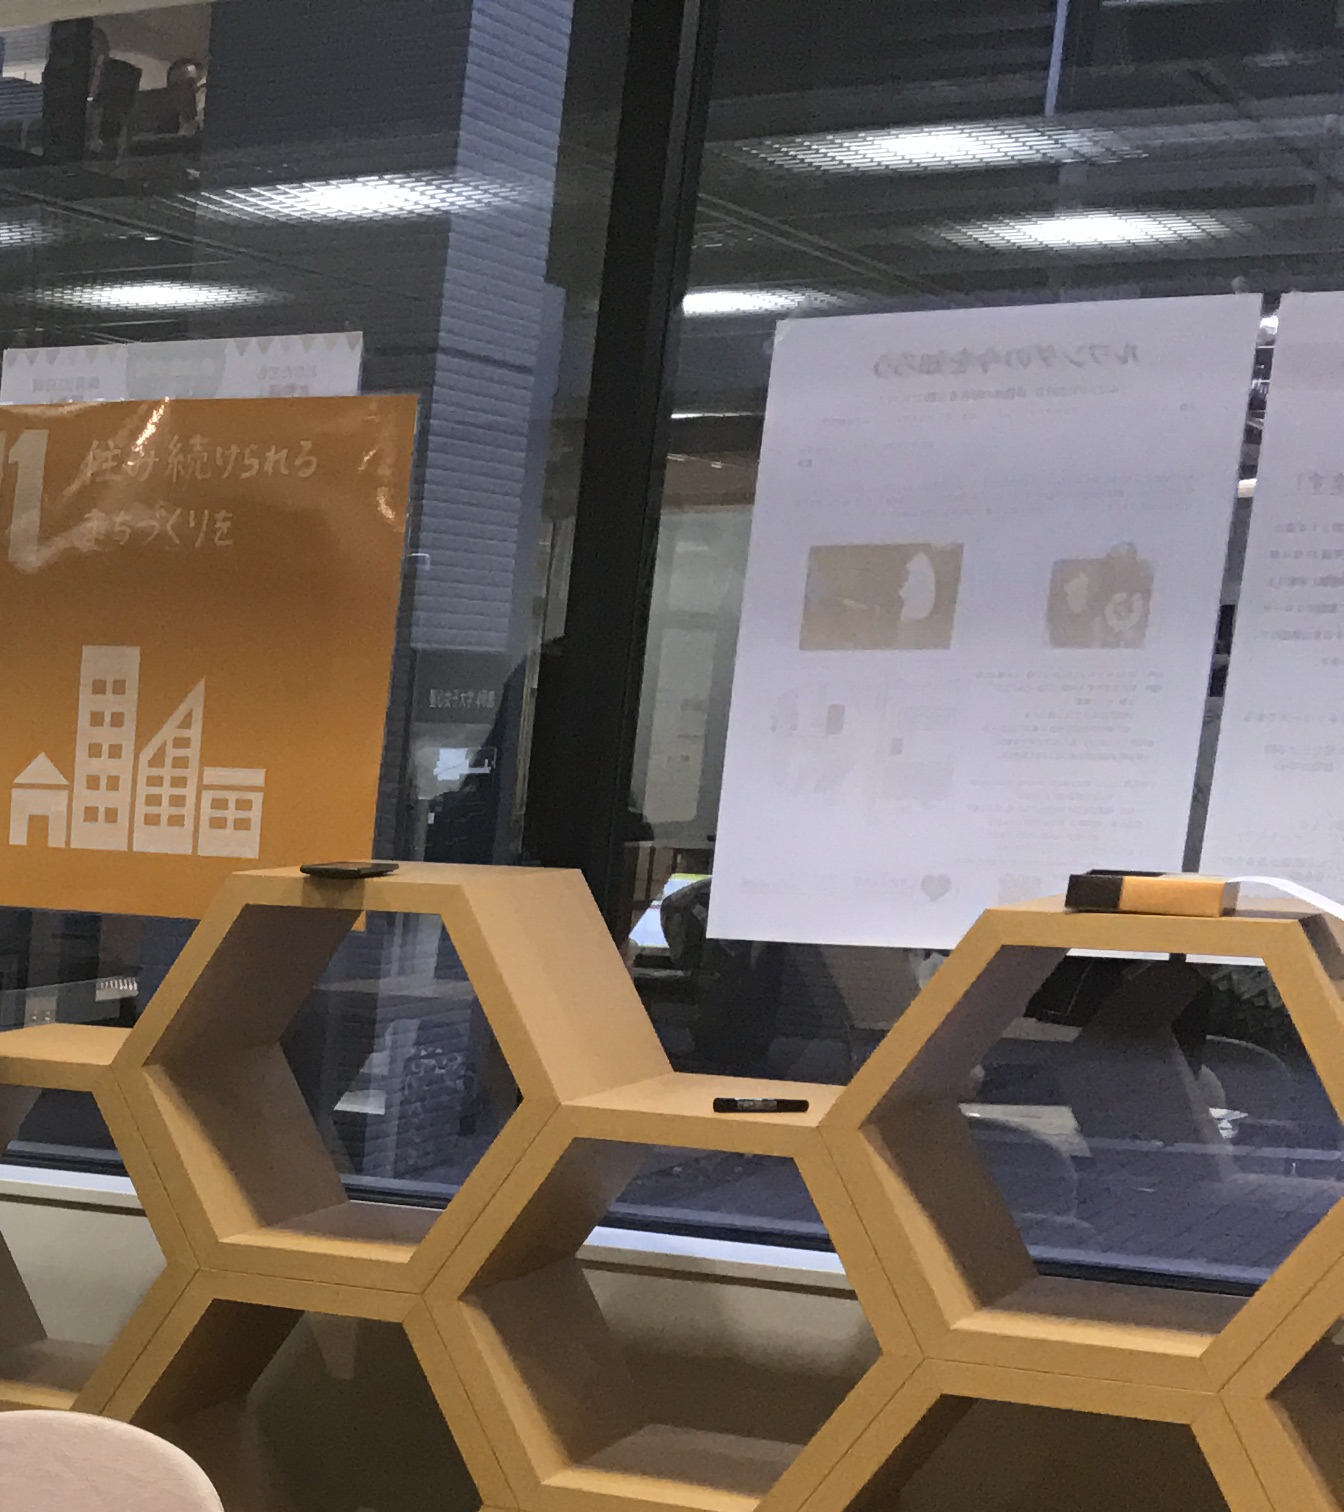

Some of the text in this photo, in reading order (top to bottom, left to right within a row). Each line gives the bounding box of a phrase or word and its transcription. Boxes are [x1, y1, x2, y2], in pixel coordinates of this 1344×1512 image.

[83, 433, 318, 483] 住み続けられる
[82, 503, 235, 550] まちづくりを
